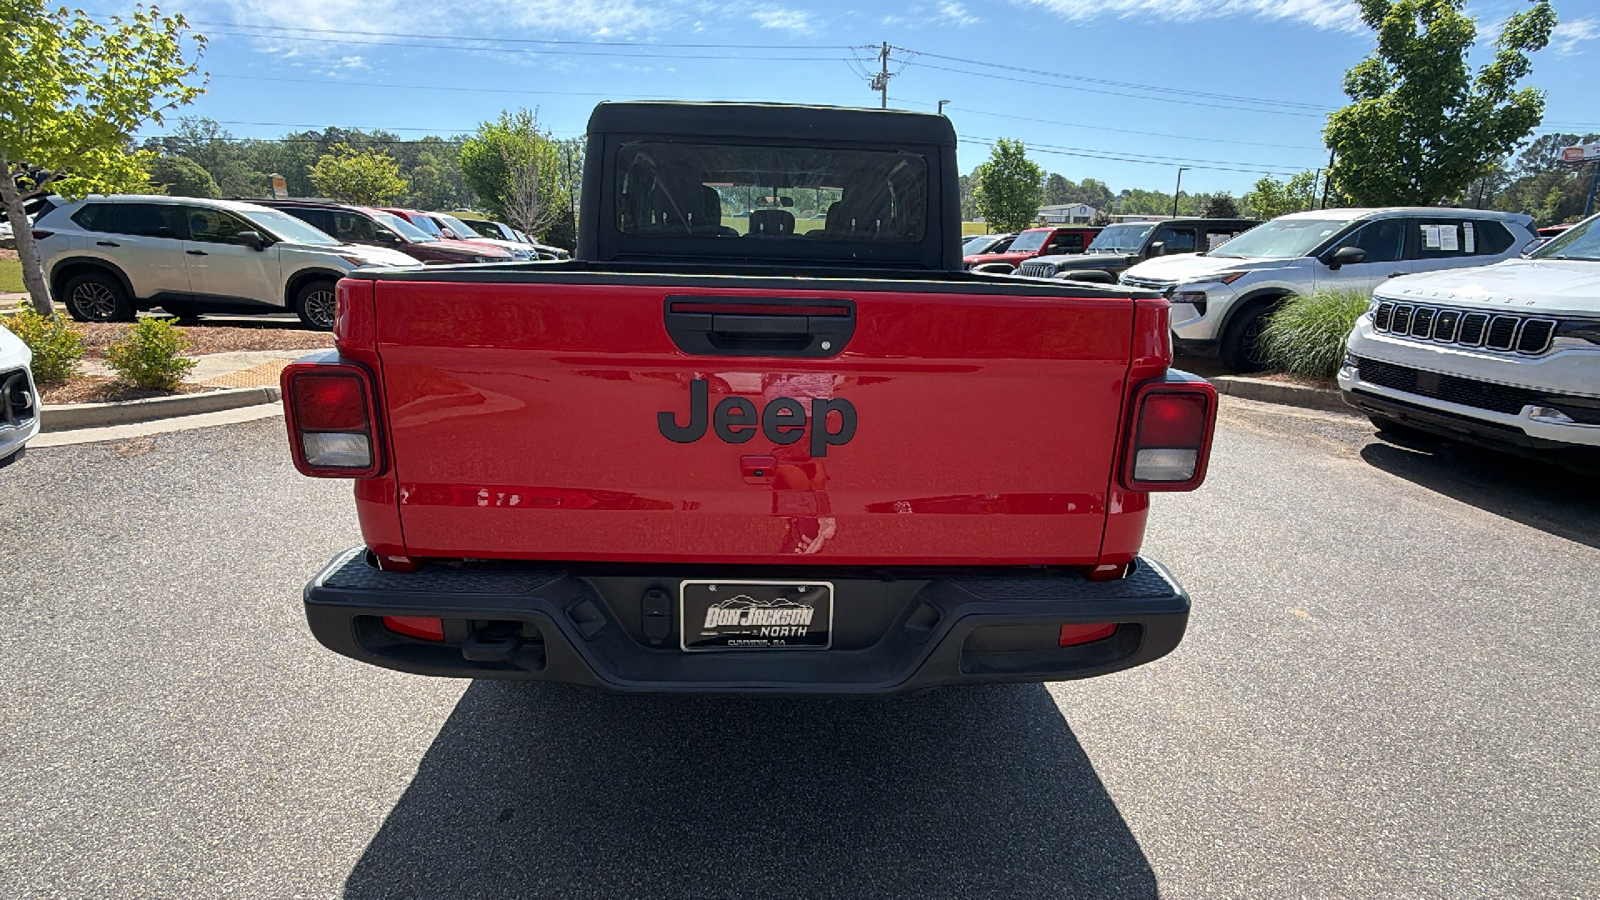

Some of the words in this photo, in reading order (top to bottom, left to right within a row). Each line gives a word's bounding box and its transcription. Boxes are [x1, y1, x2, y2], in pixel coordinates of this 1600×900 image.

[657, 379, 858, 457] Jeep
[703, 607, 741, 628] DON
[740, 606, 815, 626] JACKSON
[760, 626, 807, 637] NORTH
